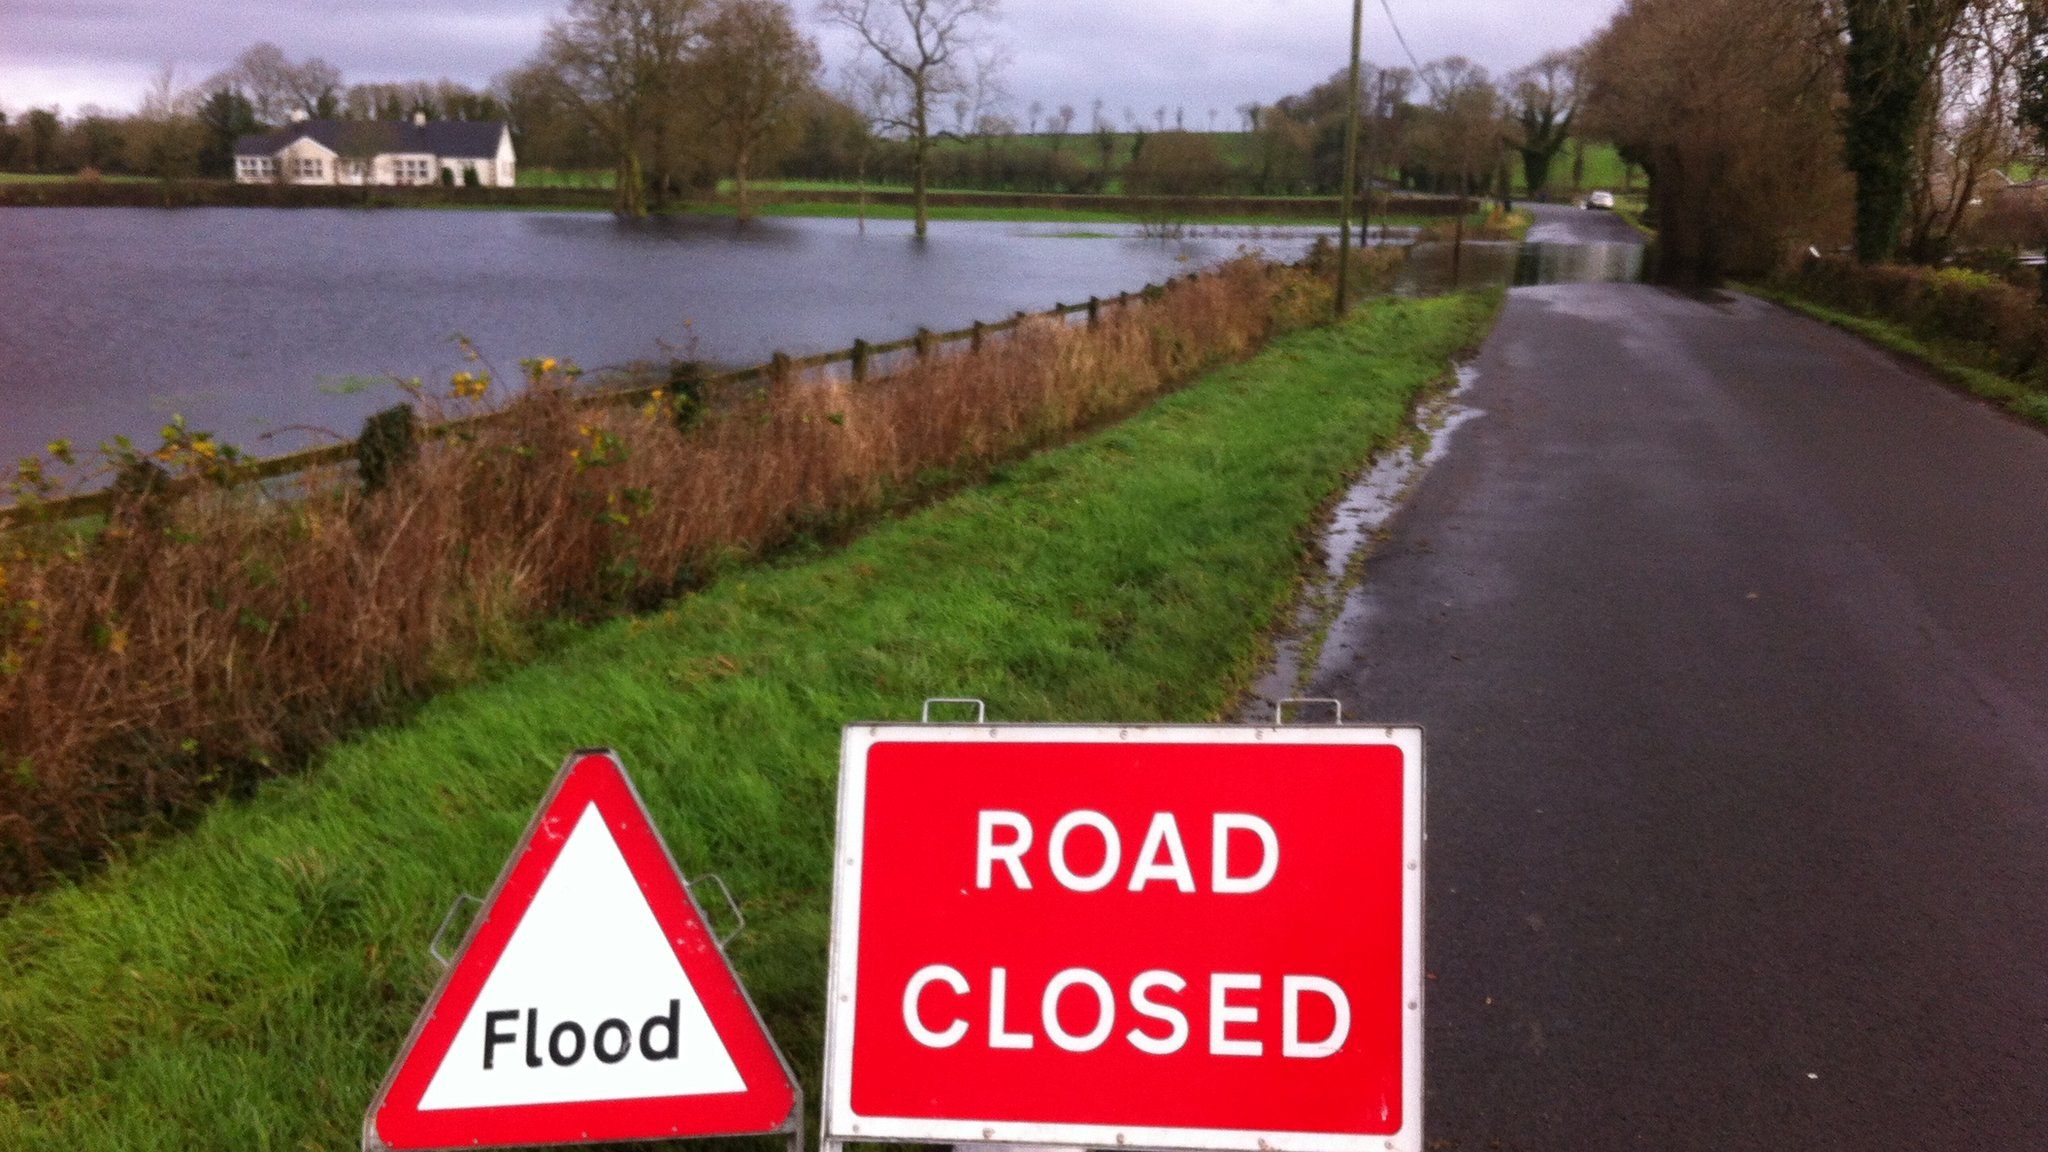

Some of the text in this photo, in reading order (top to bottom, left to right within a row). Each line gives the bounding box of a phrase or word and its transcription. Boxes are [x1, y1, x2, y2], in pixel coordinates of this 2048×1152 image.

[976, 809, 1280, 893] ROAD
[483, 999, 680, 1070] Flood
[902, 964, 1351, 1059] CLOSED
